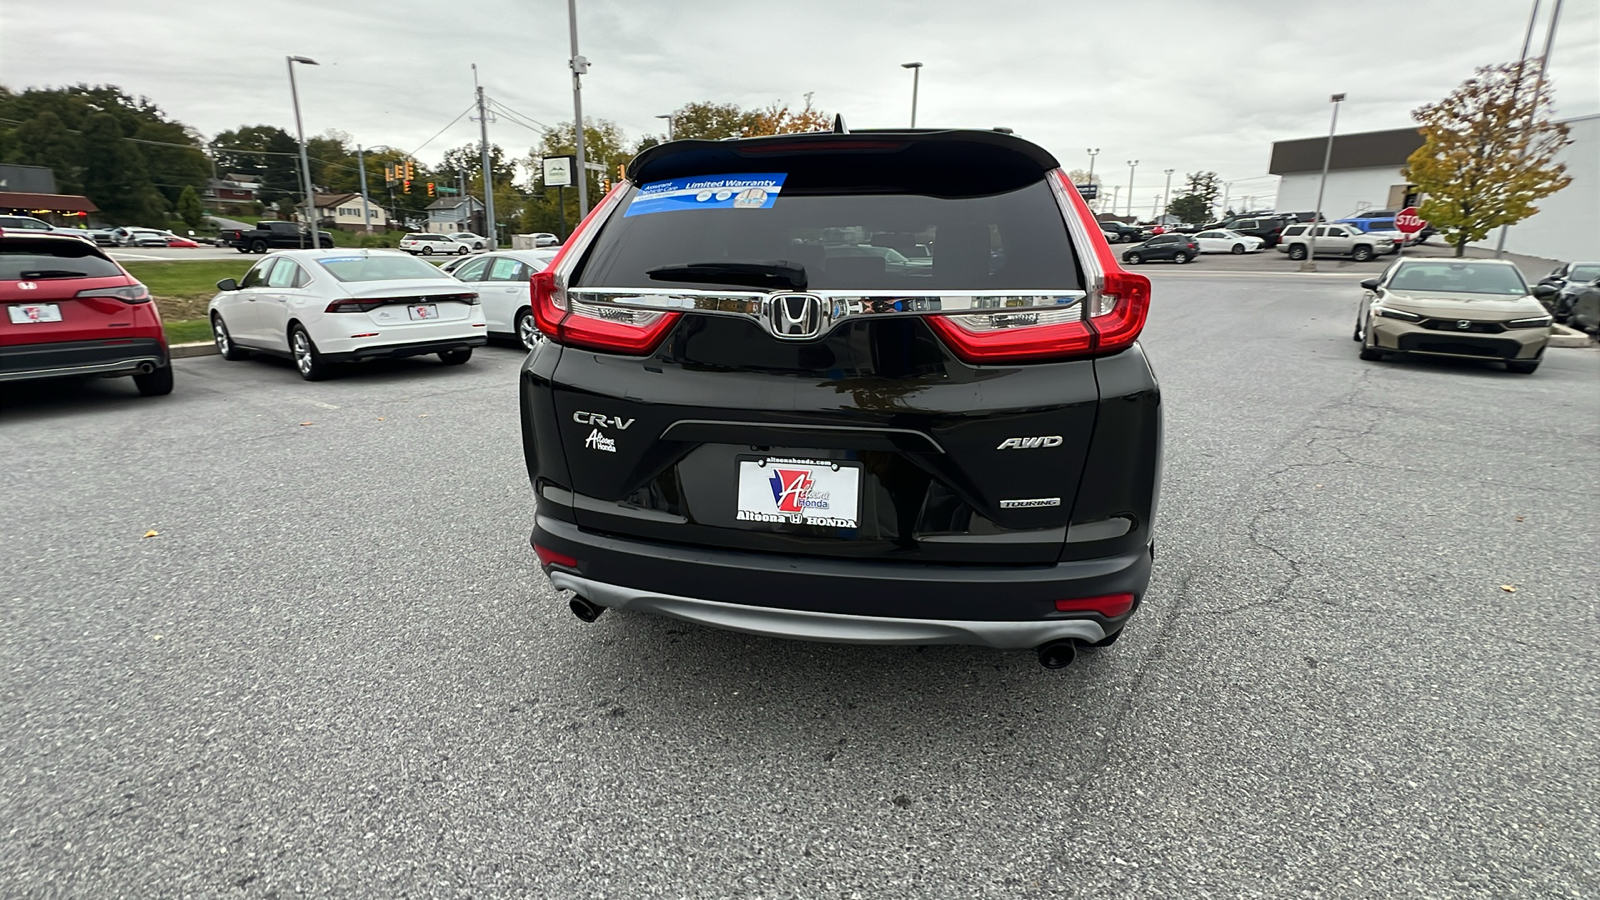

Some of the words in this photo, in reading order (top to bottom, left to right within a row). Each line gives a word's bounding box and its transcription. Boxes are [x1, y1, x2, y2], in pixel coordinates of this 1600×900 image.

[685, 180, 723, 189] Limited
[725, 179, 776, 188] Warranty
[573, 410, 636, 430] CR-V
[996, 435, 1063, 450] AWD
[766, 456, 832, 466] altoonahonda.com
[798, 499, 829, 509] Honda
[1005, 500, 1057, 508] TOURING
[736, 510, 786, 523] Altoona
[806, 516, 858, 529] HONDA
